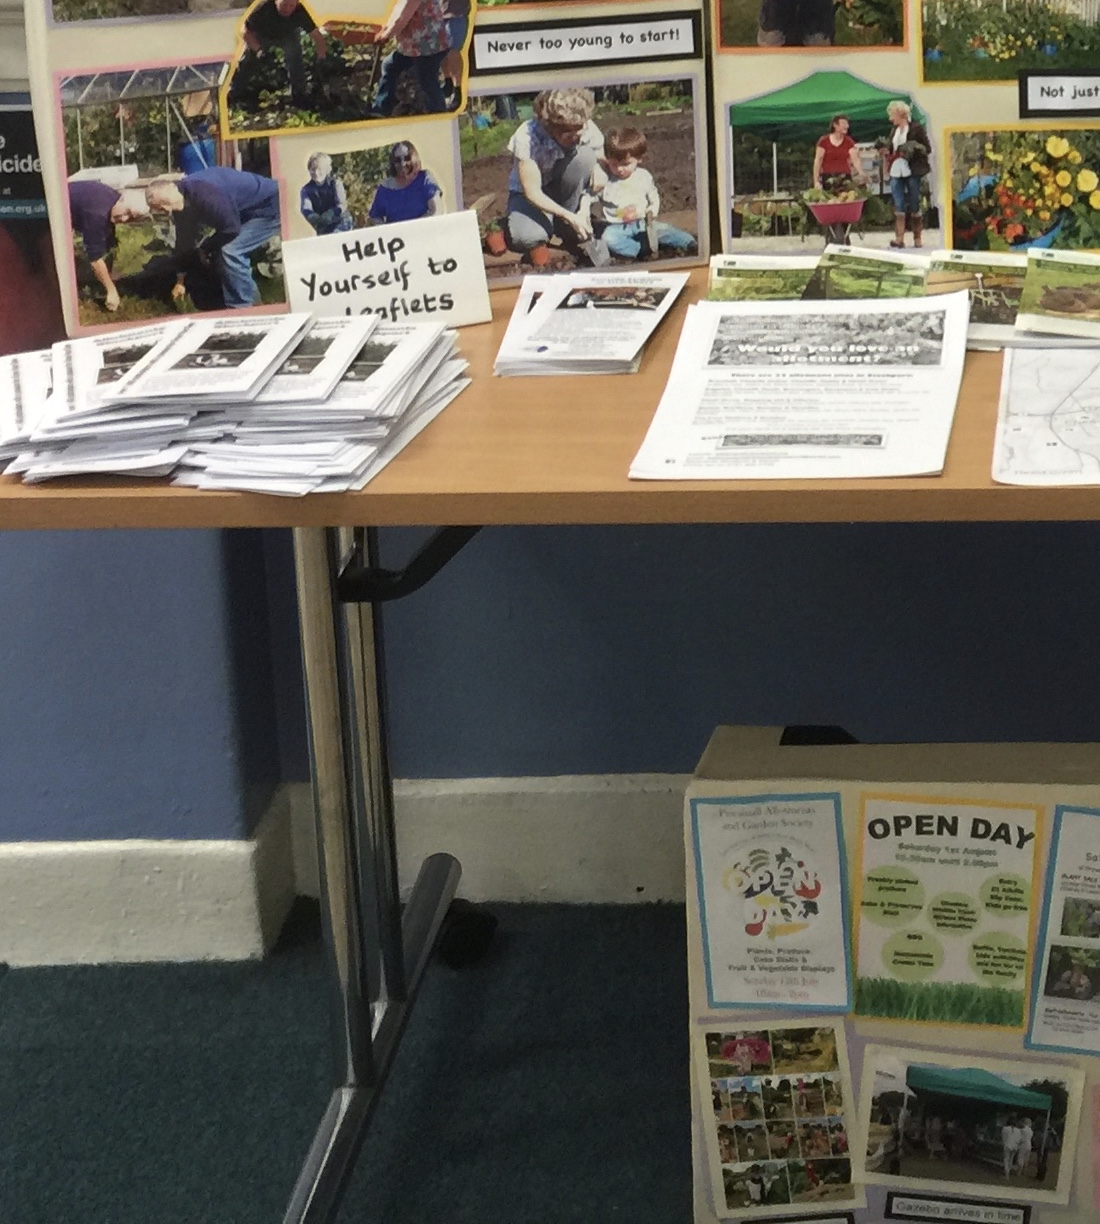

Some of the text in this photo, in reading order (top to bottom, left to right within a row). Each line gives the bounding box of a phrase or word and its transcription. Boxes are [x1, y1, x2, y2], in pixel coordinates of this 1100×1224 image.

[487, 28, 680, 53] Never too young to start!
[1040, 86, 1065, 97] Not
[1072, 85, 1100, 100] just
[342, 237, 404, 262] Help
[301, 257, 457, 301] Yourself to
[346, 293, 454, 321] aflets
[868, 815, 1035, 850] OPEN DAY
[896, 1201, 940, 1215] Gazebo
